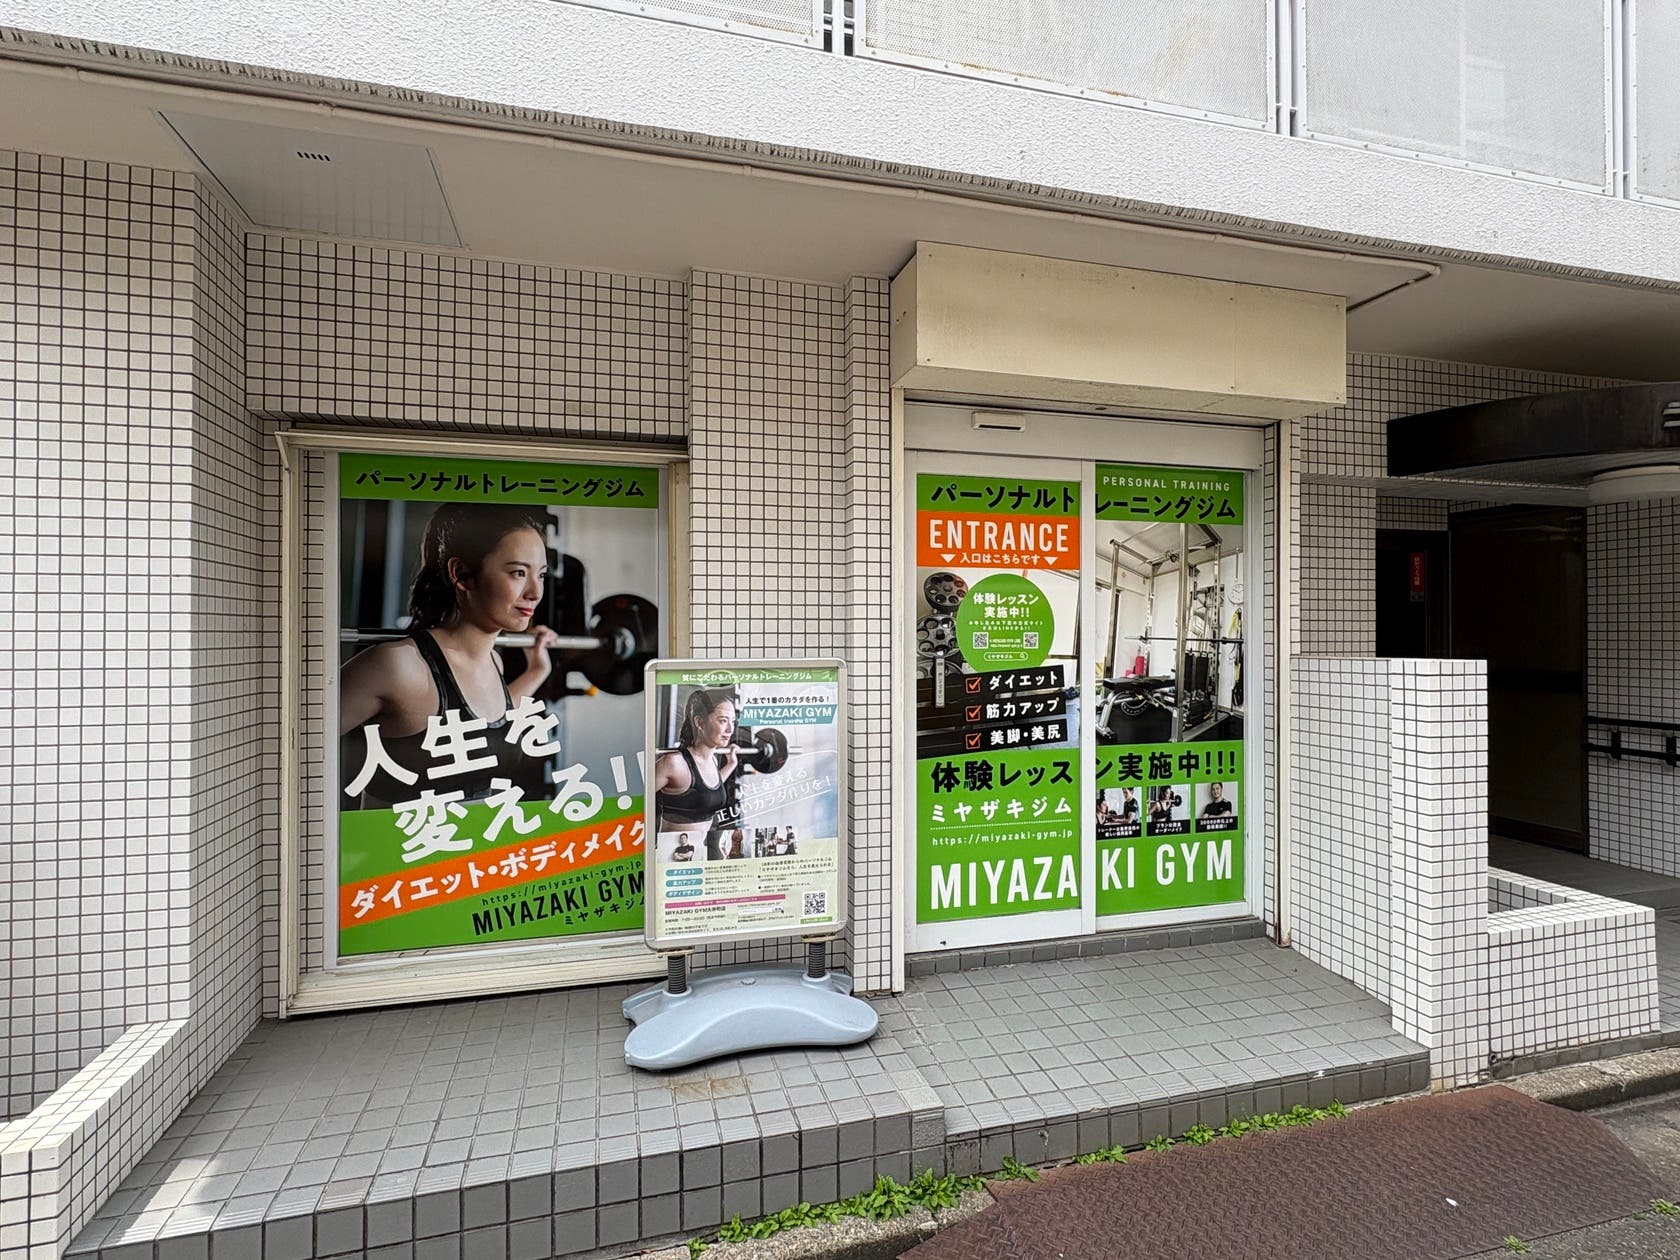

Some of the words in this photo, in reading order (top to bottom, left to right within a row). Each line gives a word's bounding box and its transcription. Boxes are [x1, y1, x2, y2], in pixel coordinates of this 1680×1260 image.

[356, 470, 644, 498] パーソナルトレーニングジム
[1103, 476, 1167, 488] PERSONAL
[1173, 480, 1230, 491] TRAINING
[929, 519, 1069, 552] ENTRANCE
[960, 552, 1041, 566] 入口はこちらです
[973, 592, 1039, 605] 体験レッスン
[984, 606, 1030, 619] 実施中!!
[989, 671, 1059, 690] ダイエット
[743, 707, 802, 719] MIYAZAKI
[806, 706, 832, 717] GYM
[986, 697, 1060, 719] 筋力アップ
[990, 724, 1061, 745] 美脚・美尻
[344, 696, 561, 797] 人生を
[931, 796, 1072, 823] ミヤザキジム
[932, 829, 1073, 846] https://miyazaki-gym.jp
[482, 860, 642, 906] https://miyazaki-gym.jp
[931, 855, 1078, 910] MIYAZA
[1102, 847, 1135, 891] KI
[1156, 839, 1232, 886] GYM
[472, 893, 588, 936] MIYAZAKI
[598, 870, 645, 903] GYM
